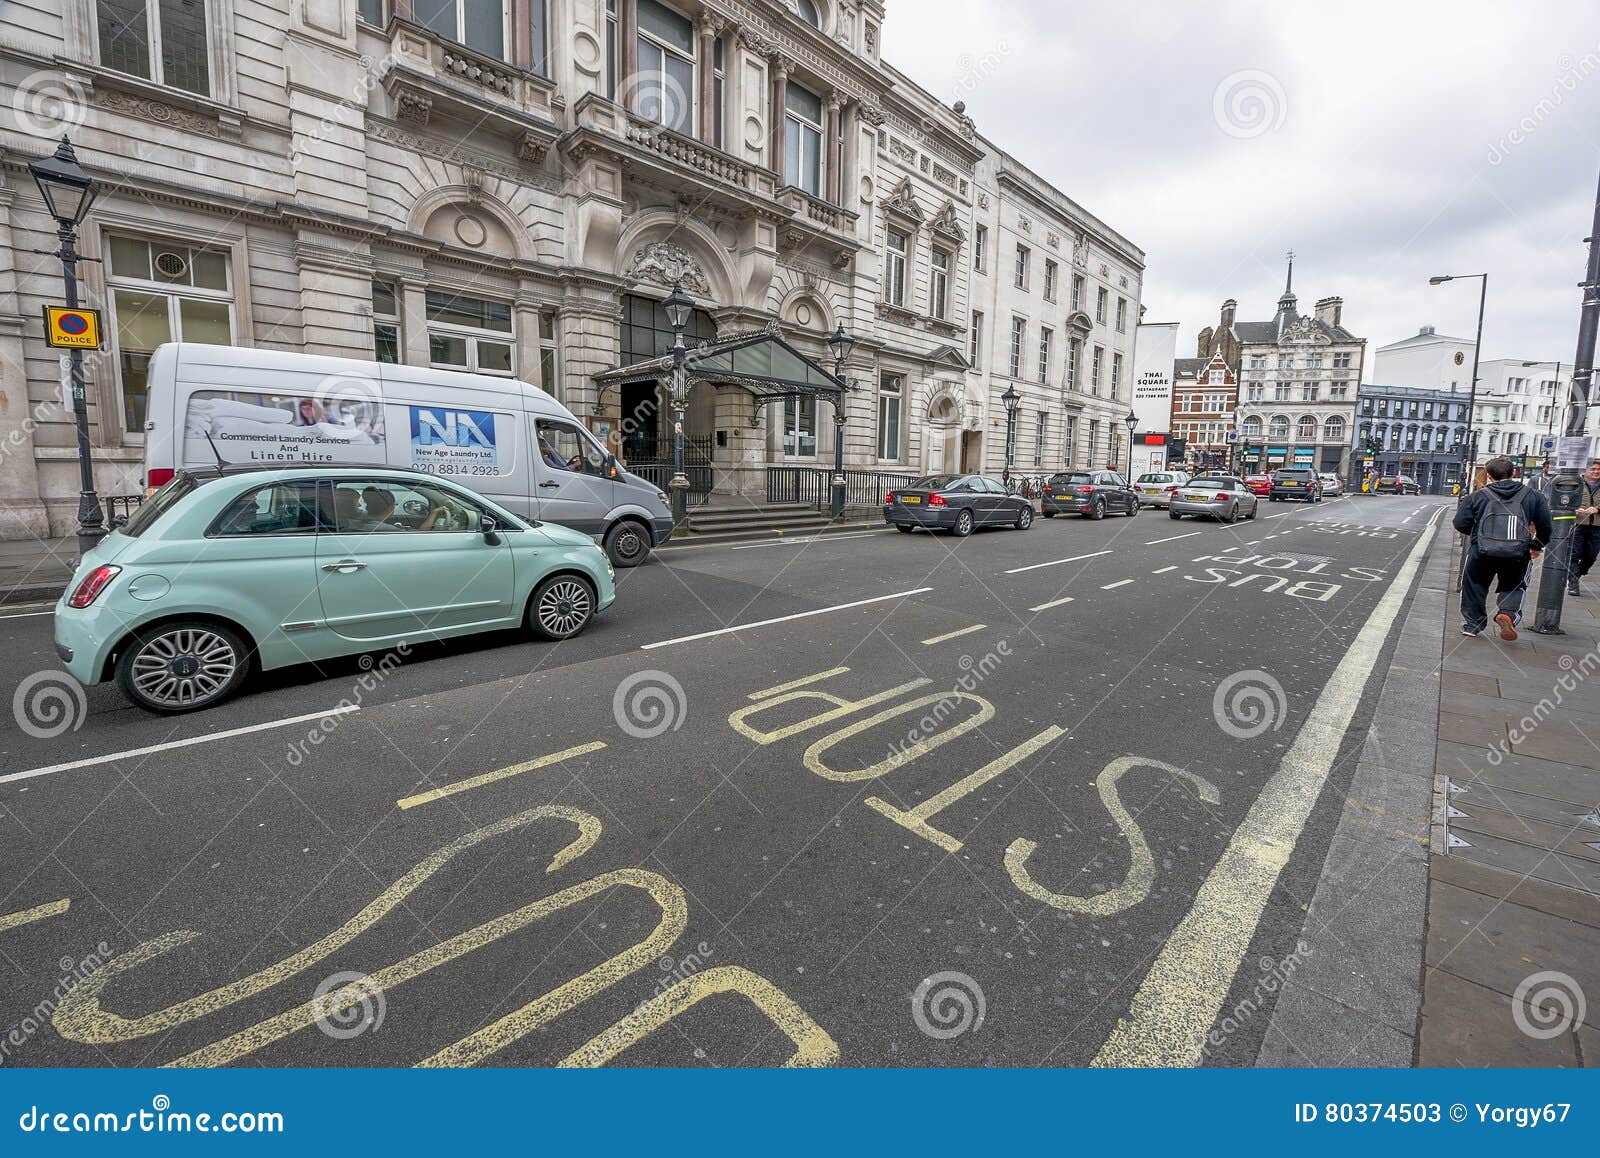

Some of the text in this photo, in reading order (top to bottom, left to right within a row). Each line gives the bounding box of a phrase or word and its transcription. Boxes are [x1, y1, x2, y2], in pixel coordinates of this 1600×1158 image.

[57, 335, 92, 344] POLICE
[220, 432, 350, 445] Commercial Laundry Services
[280, 444, 299, 452] And
[416, 448, 432, 456] New
[434, 450, 448, 458] Age
[450, 450, 478, 458] Laundry
[251, 450, 333, 461] Linen Hire
[438, 464, 468, 475] 8814
[471, 465, 500, 476] 2925
[1184, 567, 1343, 601] BUS
[728, 677, 1221, 916] STOP
